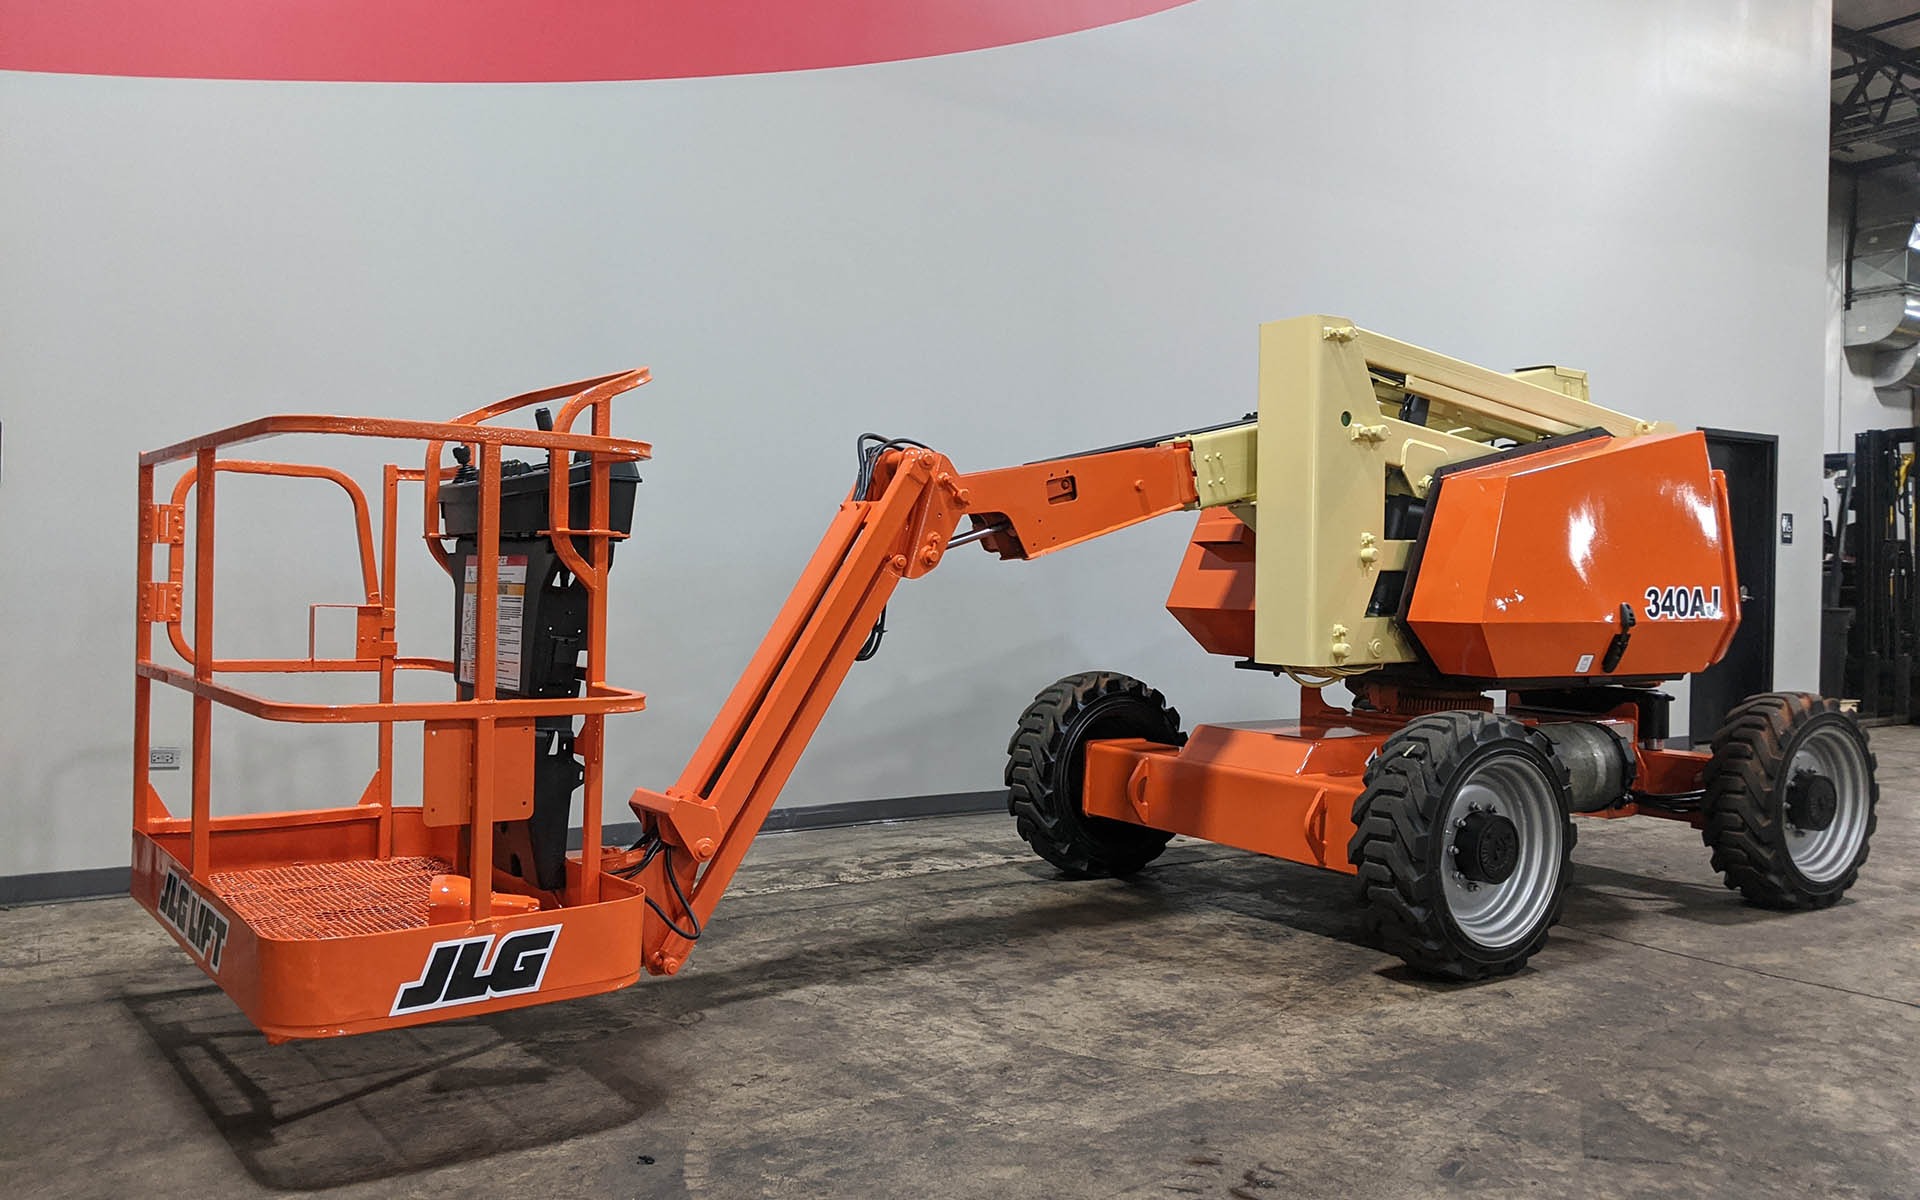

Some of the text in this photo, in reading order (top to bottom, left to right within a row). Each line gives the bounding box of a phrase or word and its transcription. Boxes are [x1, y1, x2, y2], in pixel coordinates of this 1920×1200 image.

[1645, 587, 1720, 618] 340AJ
[159, 869, 229, 970] JLG LIFT
[393, 926, 560, 1014] JLG
